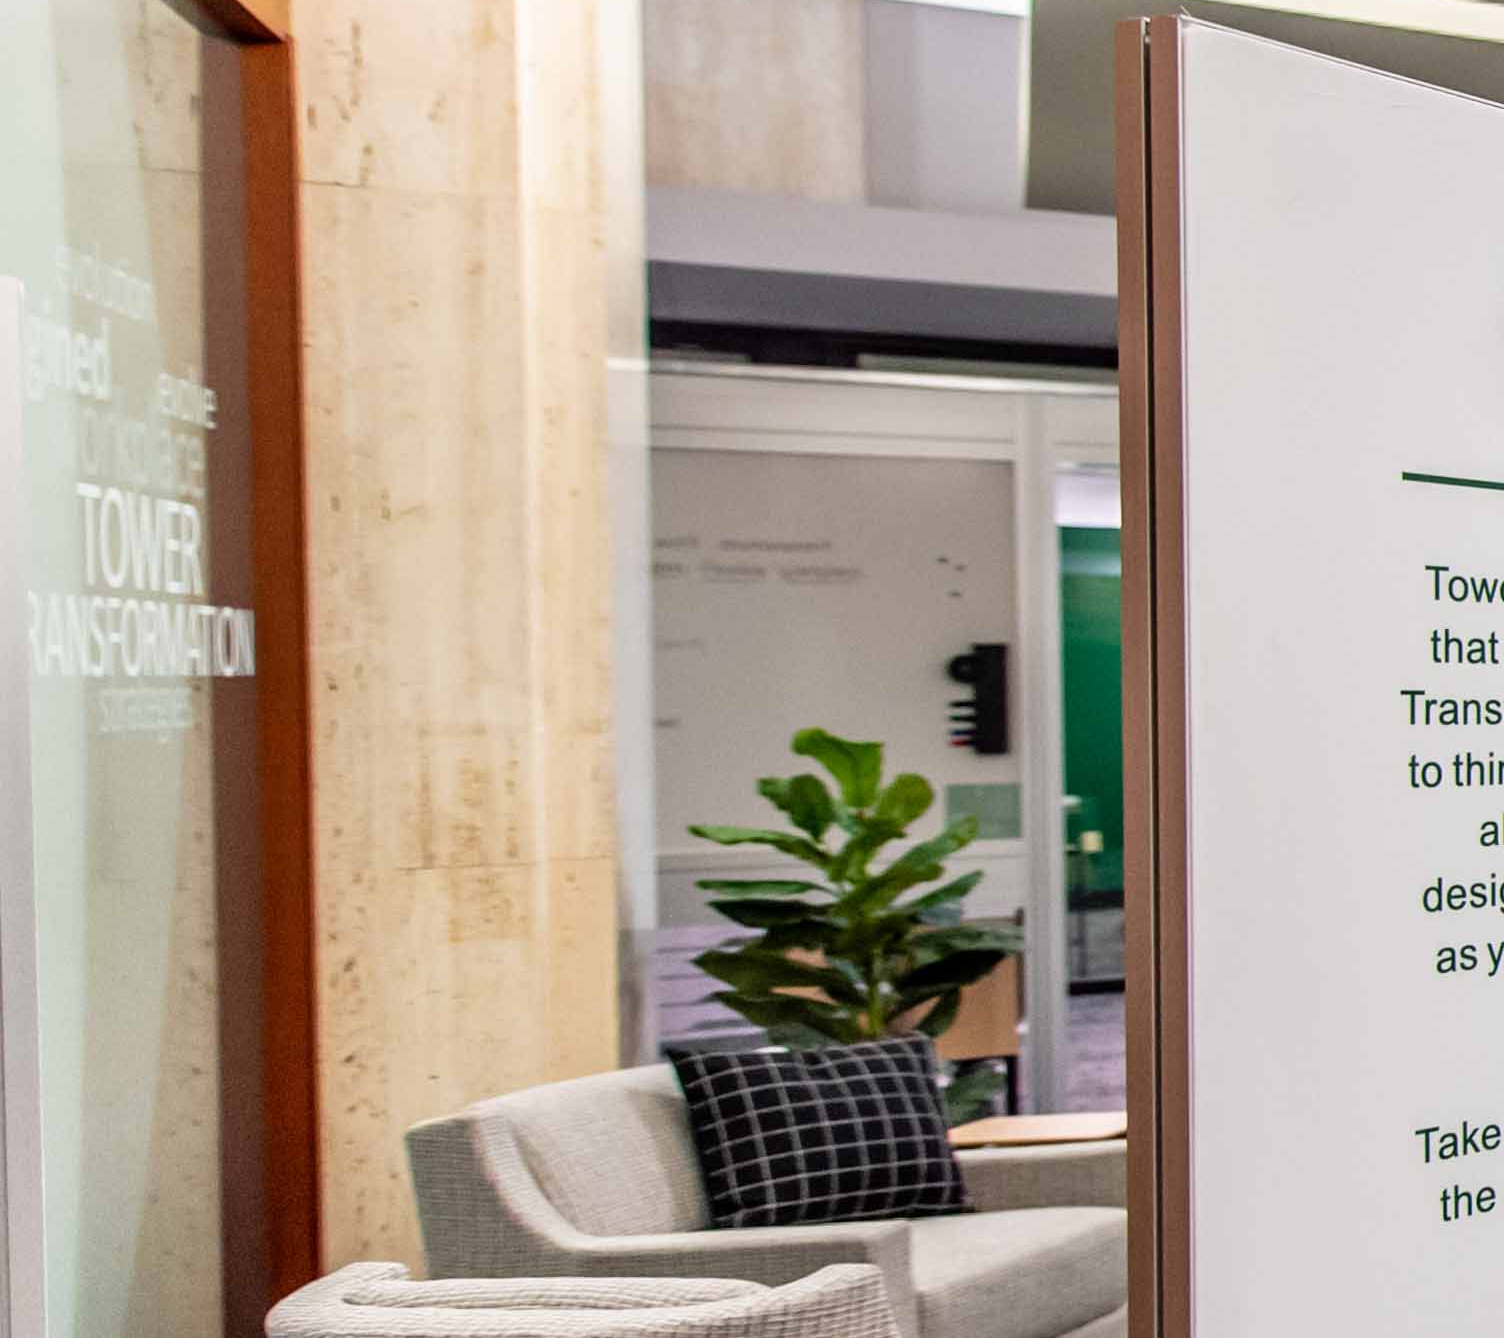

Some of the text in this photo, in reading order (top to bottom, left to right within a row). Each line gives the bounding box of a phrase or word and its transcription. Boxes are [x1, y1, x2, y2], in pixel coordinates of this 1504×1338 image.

[76, 482, 205, 596] TOWER
[27, 591, 256, 676] RANSFORMATION
[1429, 628, 1500, 665] that
[1407, 753, 1443, 789] to
[1436, 944, 1479, 974] as
[1414, 1120, 1502, 1164] Take
[1439, 1183, 1497, 1222] the
